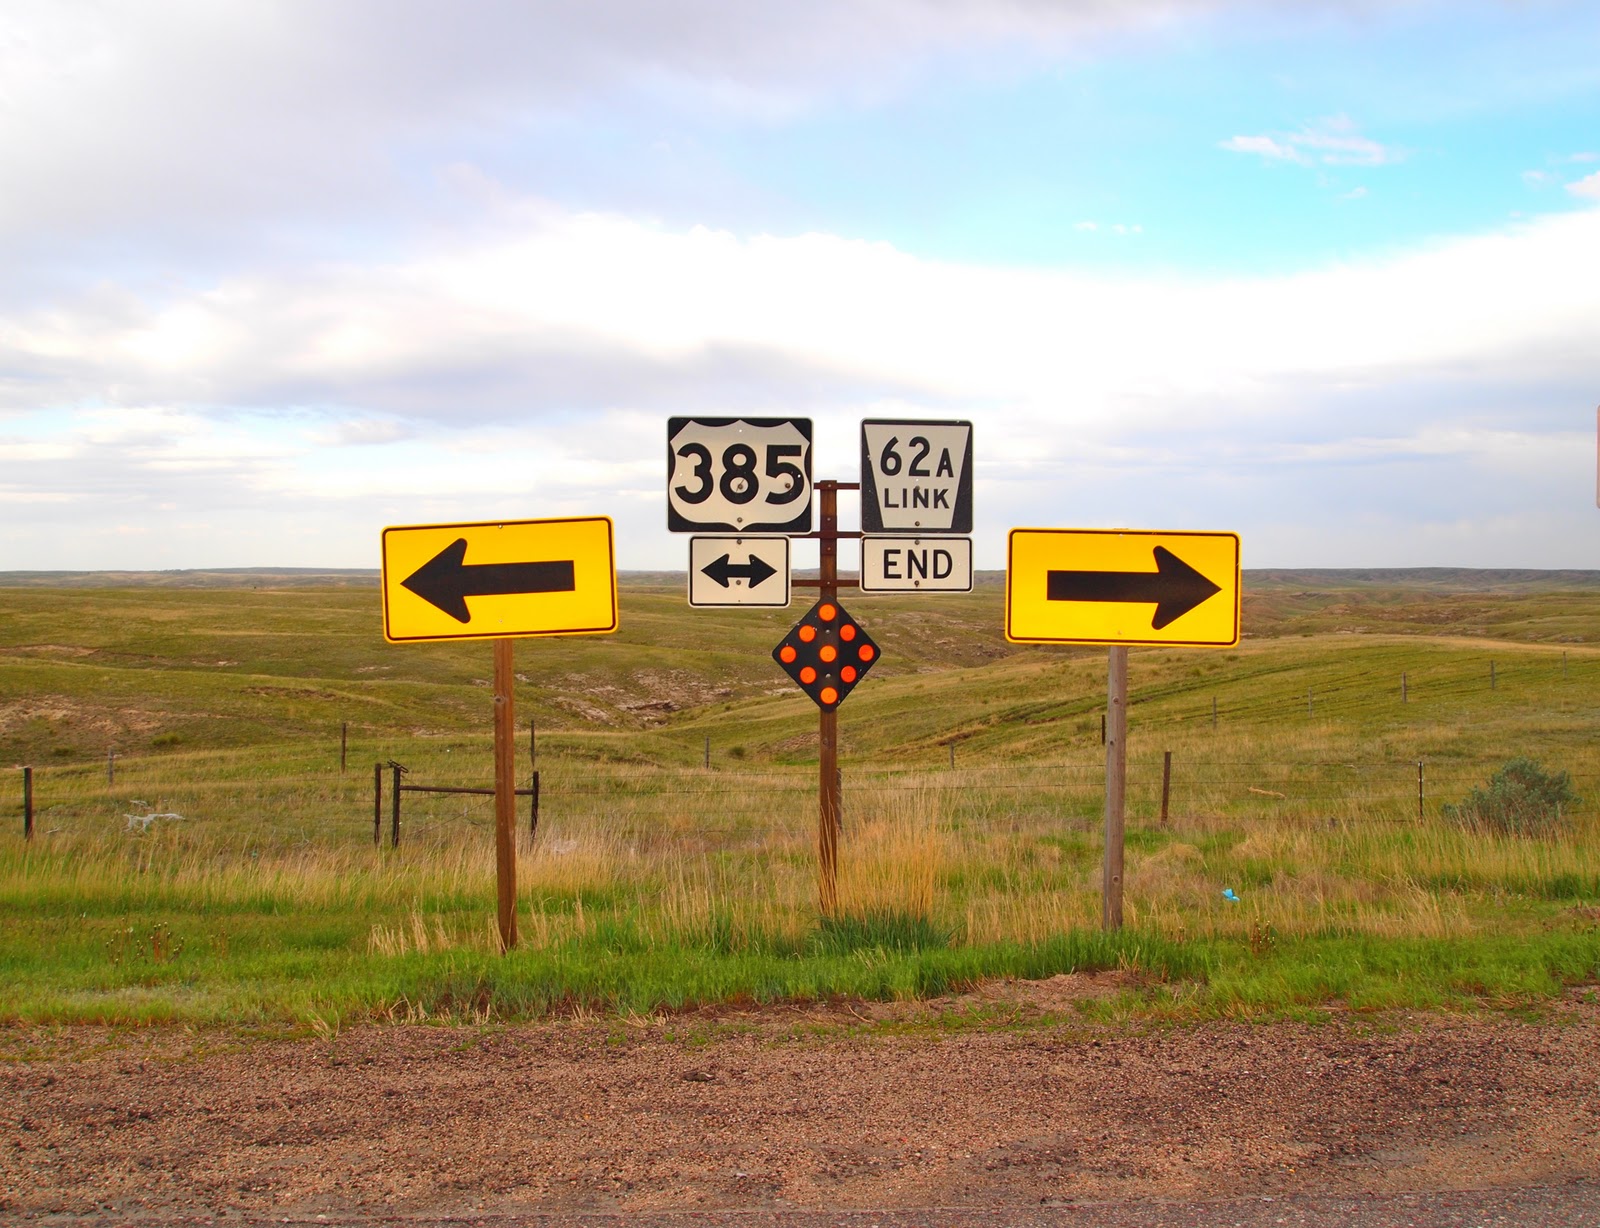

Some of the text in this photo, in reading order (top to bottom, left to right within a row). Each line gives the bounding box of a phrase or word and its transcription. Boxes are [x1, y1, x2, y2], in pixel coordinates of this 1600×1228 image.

[674, 442, 805, 505] 385
[880, 436, 954, 478] 62A
[884, 487, 950, 509] LINK
[883, 549, 953, 579] END
